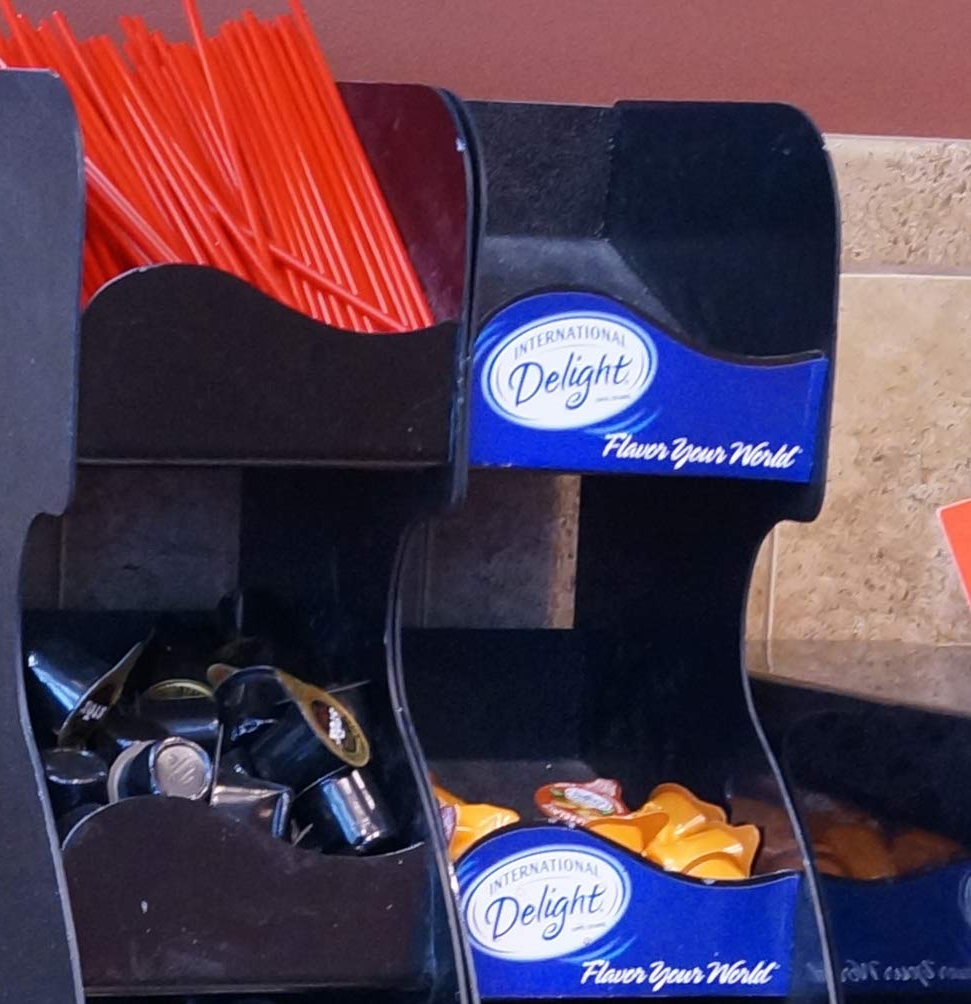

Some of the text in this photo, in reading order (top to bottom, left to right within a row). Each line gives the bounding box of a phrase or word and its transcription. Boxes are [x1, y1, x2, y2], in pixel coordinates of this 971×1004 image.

[514, 326, 627, 359] INTERNATIONAL
[508, 353, 632, 410] Delight
[602, 432, 800, 470] Flavor Your World
[487, 858, 600, 896] INTERNATIONAL
[485, 885, 606, 942] Delight
[580, 960, 776, 992] Flavor Your World
